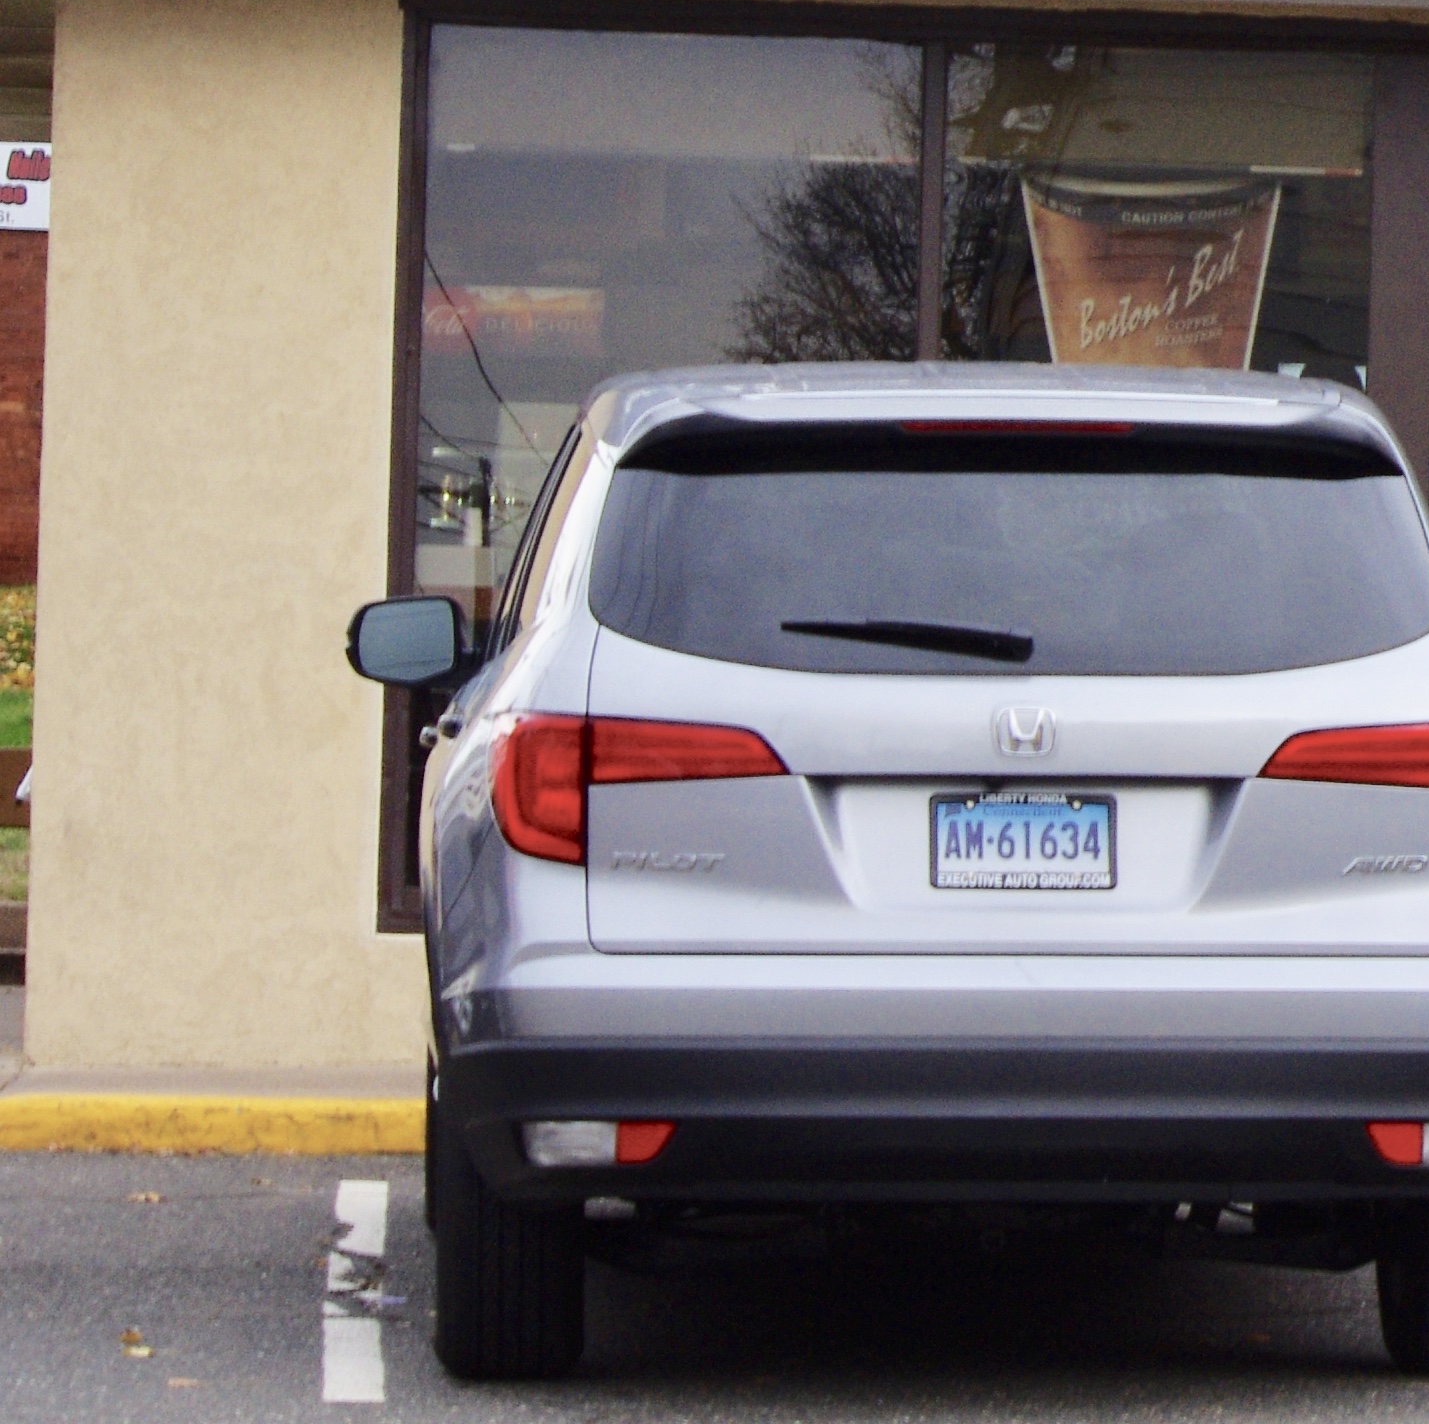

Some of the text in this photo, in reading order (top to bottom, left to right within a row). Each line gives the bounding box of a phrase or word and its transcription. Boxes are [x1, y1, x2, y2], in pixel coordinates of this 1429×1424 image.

[1121, 210, 1184, 224] CAUTION
[1078, 227, 1245, 349] Boston's Best
[979, 792, 1068, 804] LIBERTY HONDA
[610, 850, 726, 874] PILOT
